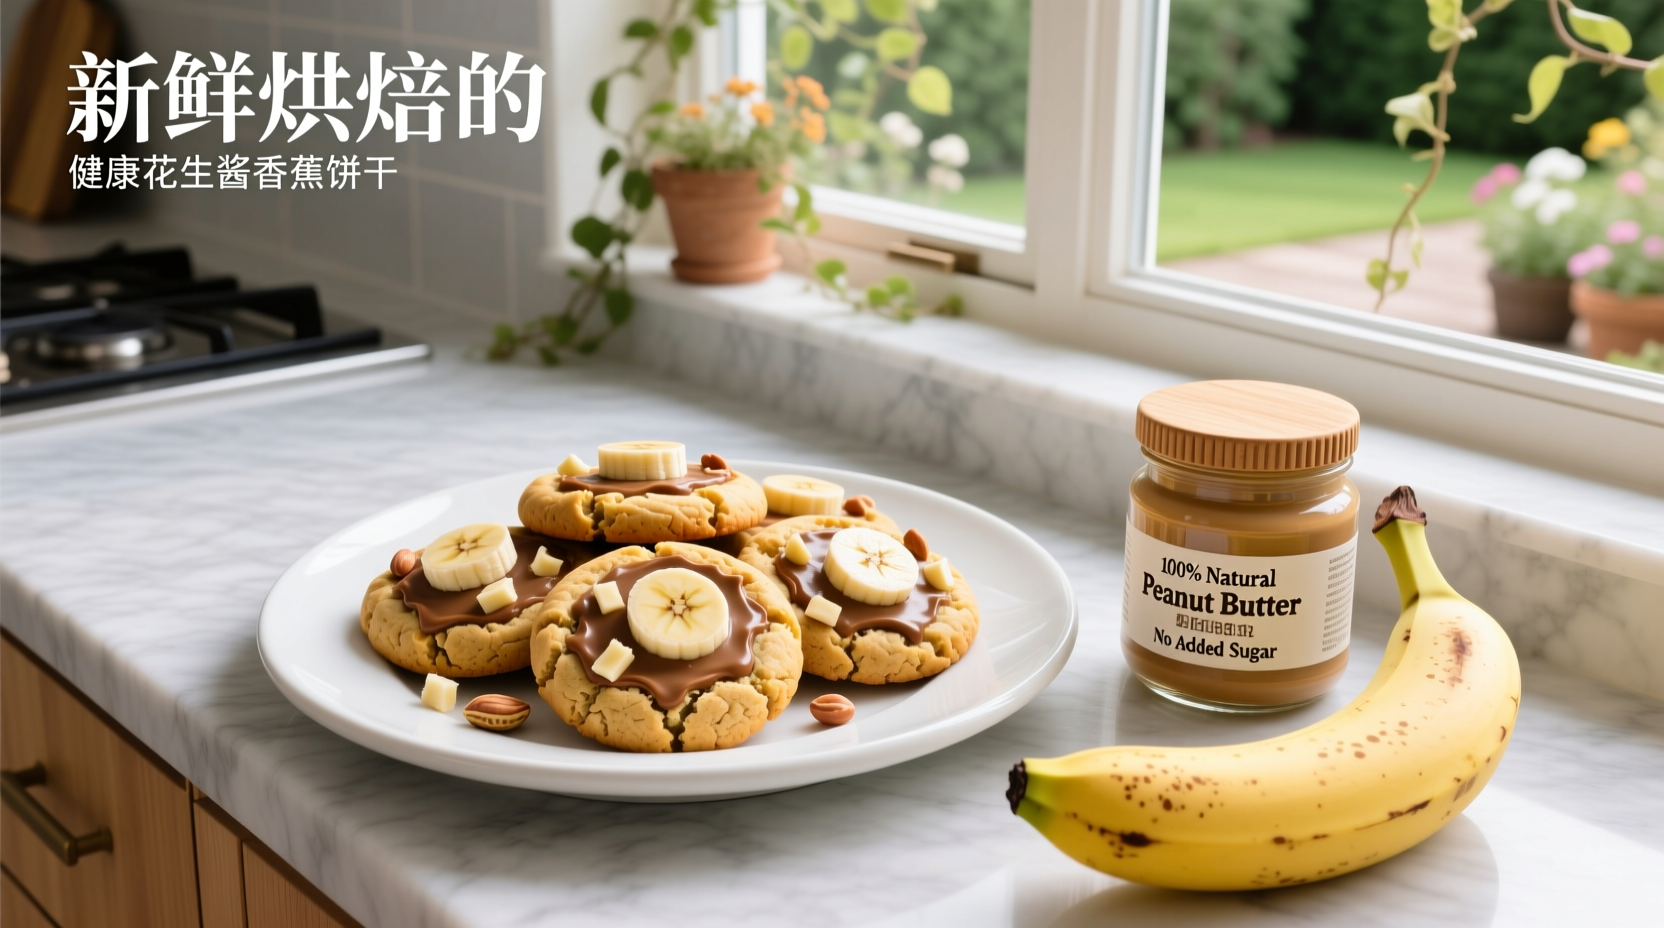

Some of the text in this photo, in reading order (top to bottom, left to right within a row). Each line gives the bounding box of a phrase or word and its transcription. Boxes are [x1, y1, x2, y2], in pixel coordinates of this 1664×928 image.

[1160, 556, 1277, 587] 100% Natural
[1142, 571, 1302, 616] Peanut Butter
[1153, 626, 1278, 663] No Added Sugar
